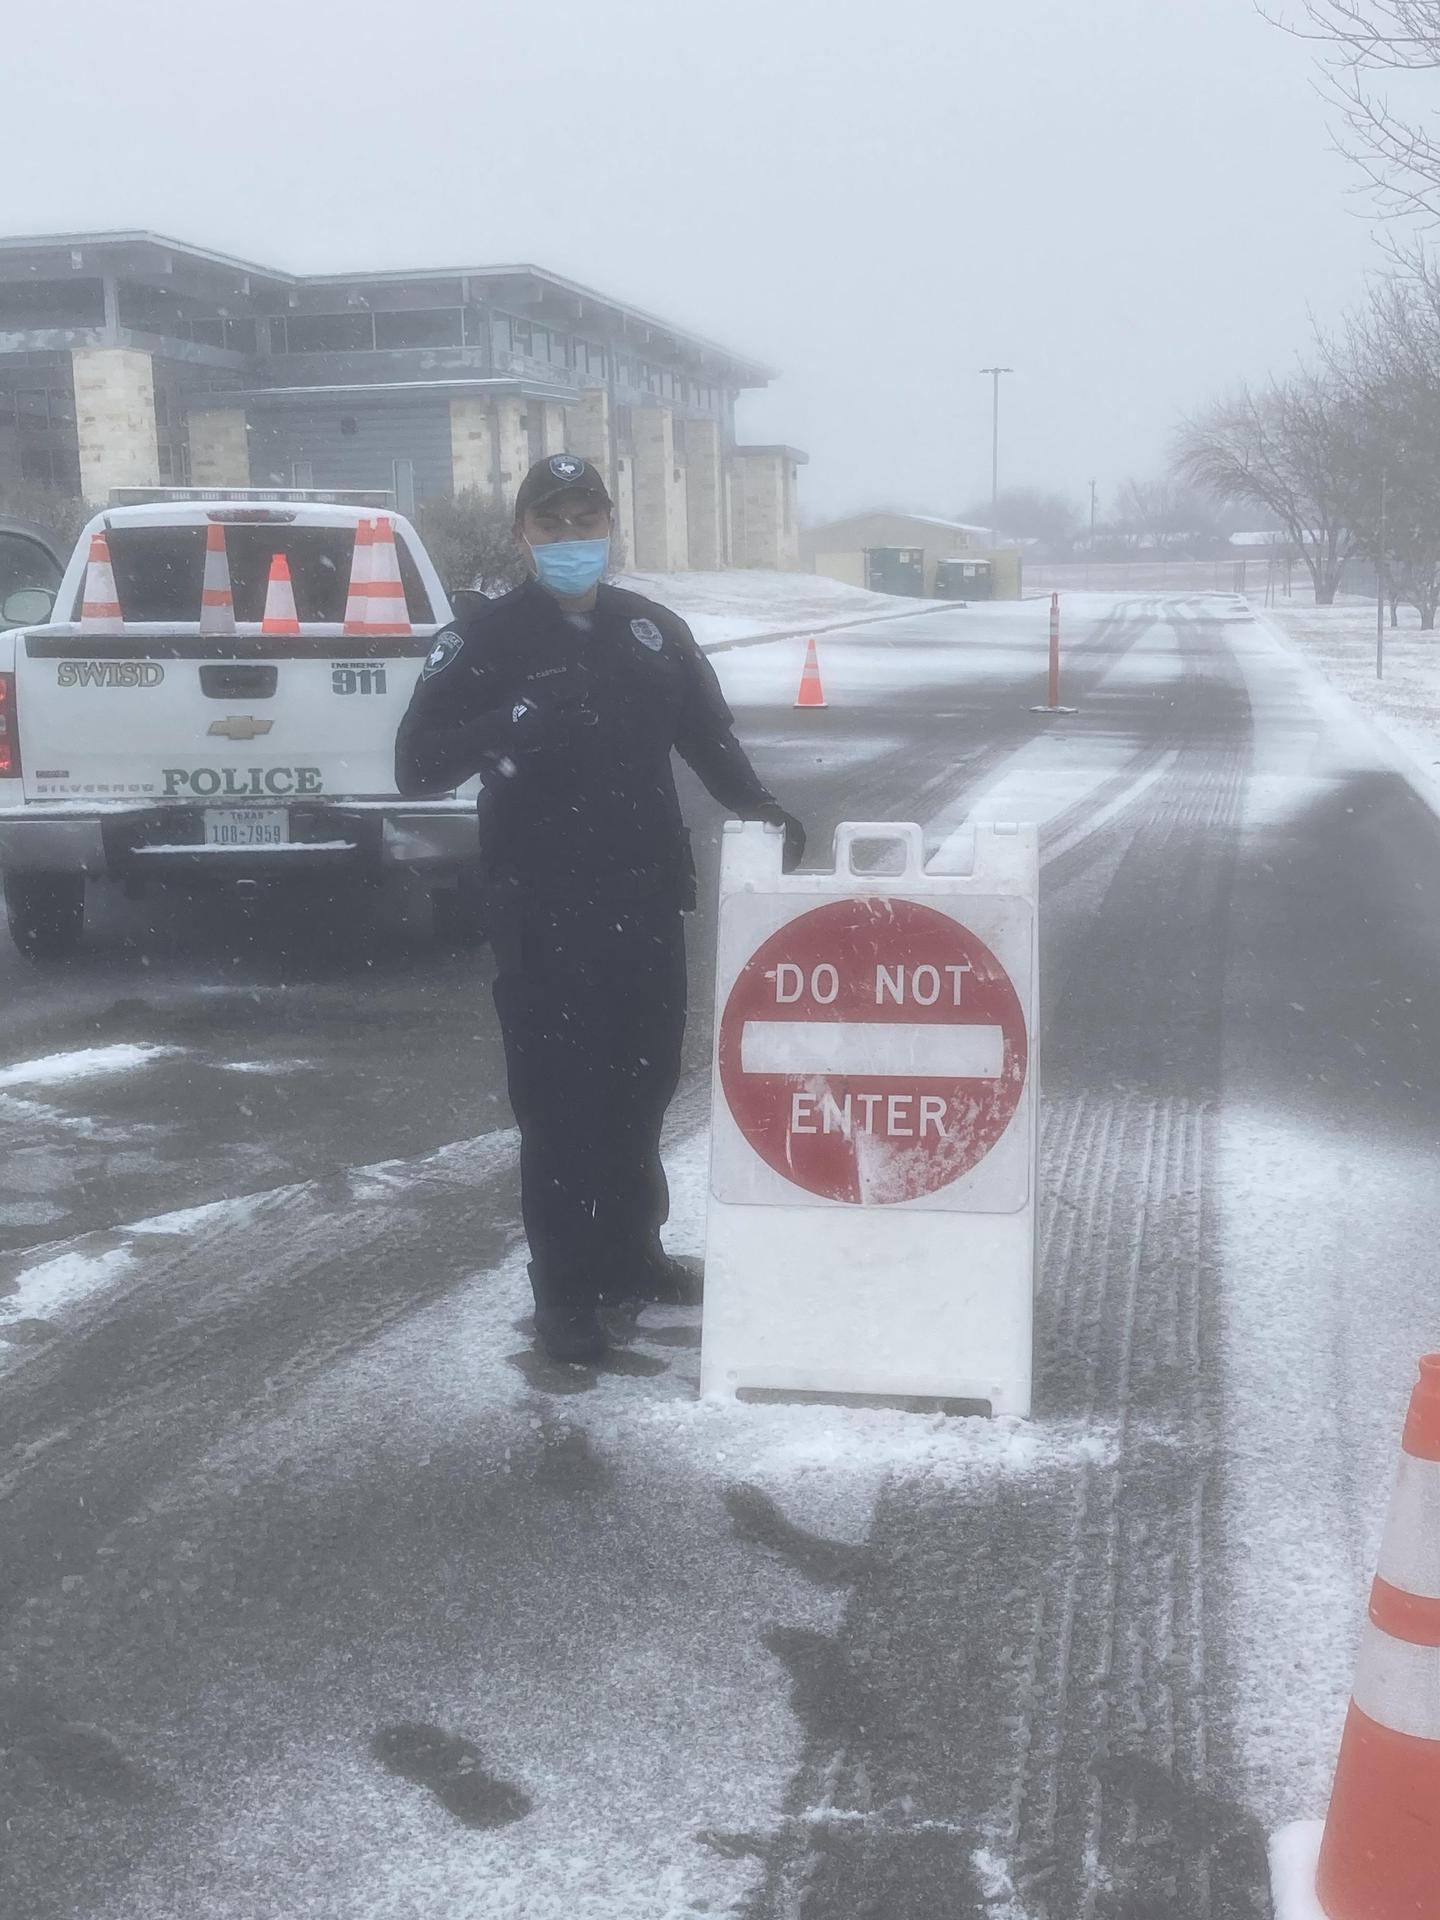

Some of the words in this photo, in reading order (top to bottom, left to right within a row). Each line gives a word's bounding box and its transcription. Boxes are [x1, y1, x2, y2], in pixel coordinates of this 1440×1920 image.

[57, 661, 164, 688] SWISD
[332, 669, 387, 695] 911
[161, 767, 324, 796] POLICE
[230, 811, 264, 821] TEXAS
[775, 963, 840, 1004] DO
[875, 963, 971, 1006] NOT
[791, 1092, 950, 1137] ENTER
